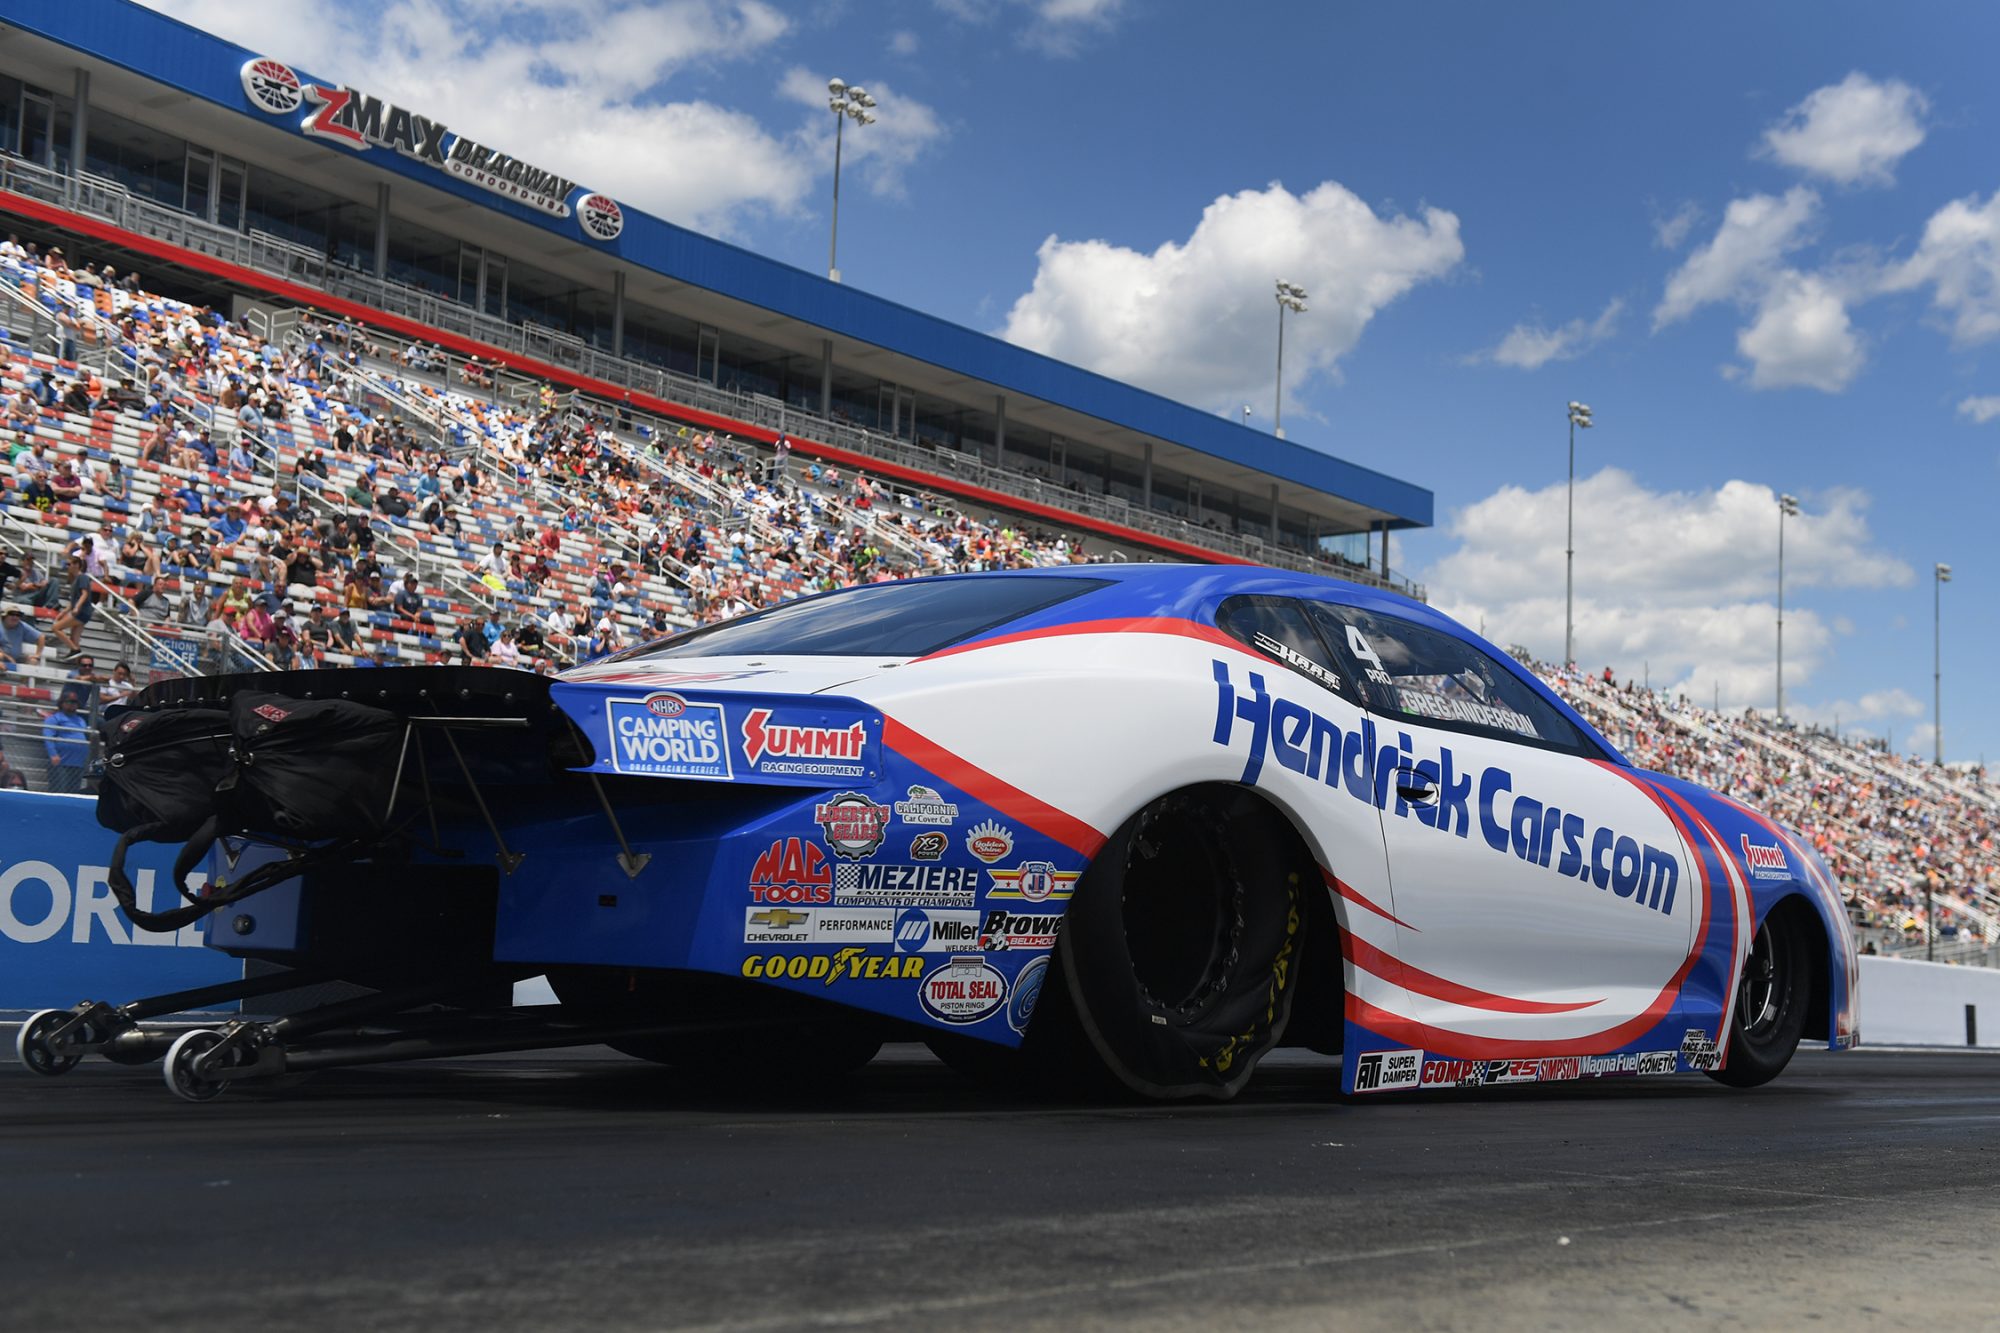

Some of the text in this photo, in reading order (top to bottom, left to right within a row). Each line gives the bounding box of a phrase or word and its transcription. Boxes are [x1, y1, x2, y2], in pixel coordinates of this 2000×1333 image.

[448, 136, 577, 203] DRAGWAY
[1344, 624, 1383, 672] 4
[1368, 668, 1392, 686] PRO
[650, 699, 681, 713] NHRA
[1401, 690, 1539, 737] GREG ANDERSON
[618, 717, 716, 740] CAMPING
[620, 737, 720, 764] WORLD
[629, 763, 720, 775] DRAG RACING SERIES
[762, 763, 865, 777] RACING EQUIPMENT
[816, 805, 890, 823] LIBERTY'S
[896, 802, 958, 816] CALIFORNIA
[903, 814, 952, 825] Car Cover Co.
[833, 824, 879, 840] GEARS
[918, 836, 940, 852] XS
[750, 837, 832, 884] MAC
[858, 865, 978, 891] MEZIERE
[749, 885, 832, 903] TOOLS
[836, 897, 973, 908] COMPONENTS OF CHAMPIONS
[0, 860, 208, 947] ORL
[819, 919, 892, 931] PERFORMANCE
[933, 921, 978, 940] Miller
[747, 933, 808, 942] CHEVROLET
[945, 945, 977, 953] WELDERS
[741, 947, 925, 986] GOODYEAR
[931, 980, 998, 1000] TOTAL SEAL
[1681, 1042, 1717, 1052] RACE STAR
[1388, 1056, 1415, 1070] SUPER
[1580, 1053, 1638, 1077] MagnaFuel
[1638, 1053, 1677, 1073] COMETIC
[1693, 1053, 1715, 1068] PRO
[1356, 1055, 1383, 1090] ATI
[1382, 1069, 1417, 1084] DAMPER
[1422, 1061, 1473, 1084] COMP
[1539, 1059, 1580, 1081] SIMPSON
[1455, 1077, 1481, 1088] CAMS
